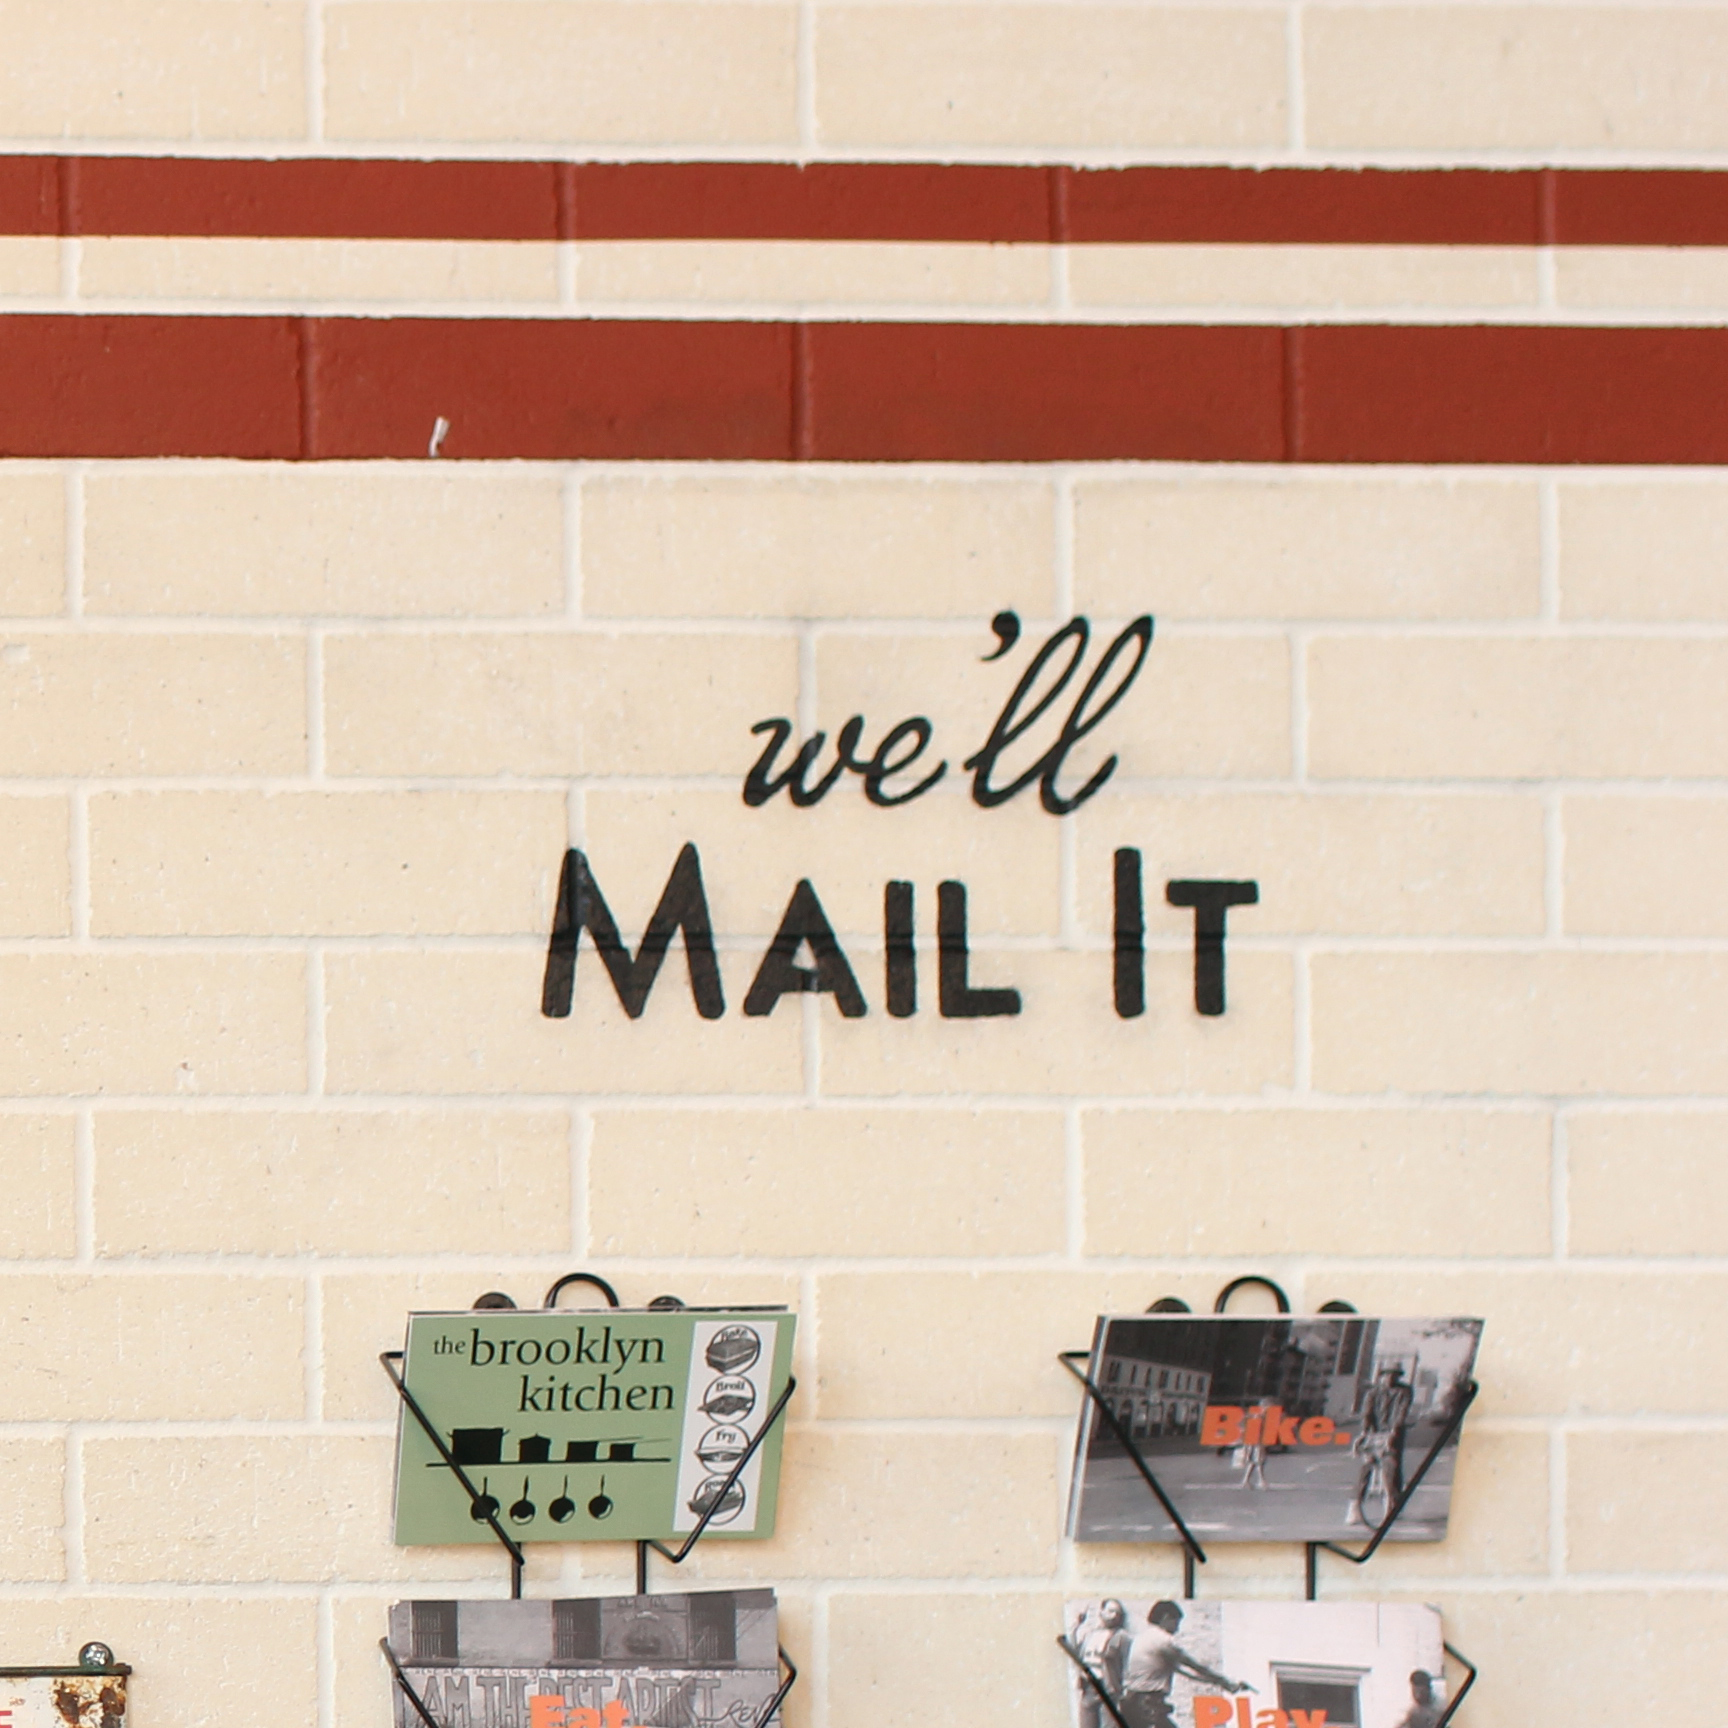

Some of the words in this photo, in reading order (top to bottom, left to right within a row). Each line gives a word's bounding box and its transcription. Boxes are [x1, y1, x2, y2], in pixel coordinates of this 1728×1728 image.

[742, 610, 1154, 815] we'll
[540, 841, 1022, 1020] MAIL
[1113, 847, 1260, 1018] IT
[433, 1334, 466, 1354] the
[470, 1322, 666, 1379] brooklyn
[517, 1370, 676, 1415] kitchen
[716, 1380, 745, 1391] Broil
[716, 1428, 738, 1443] Fry
[1202, 1407, 1350, 1445] Bike.
